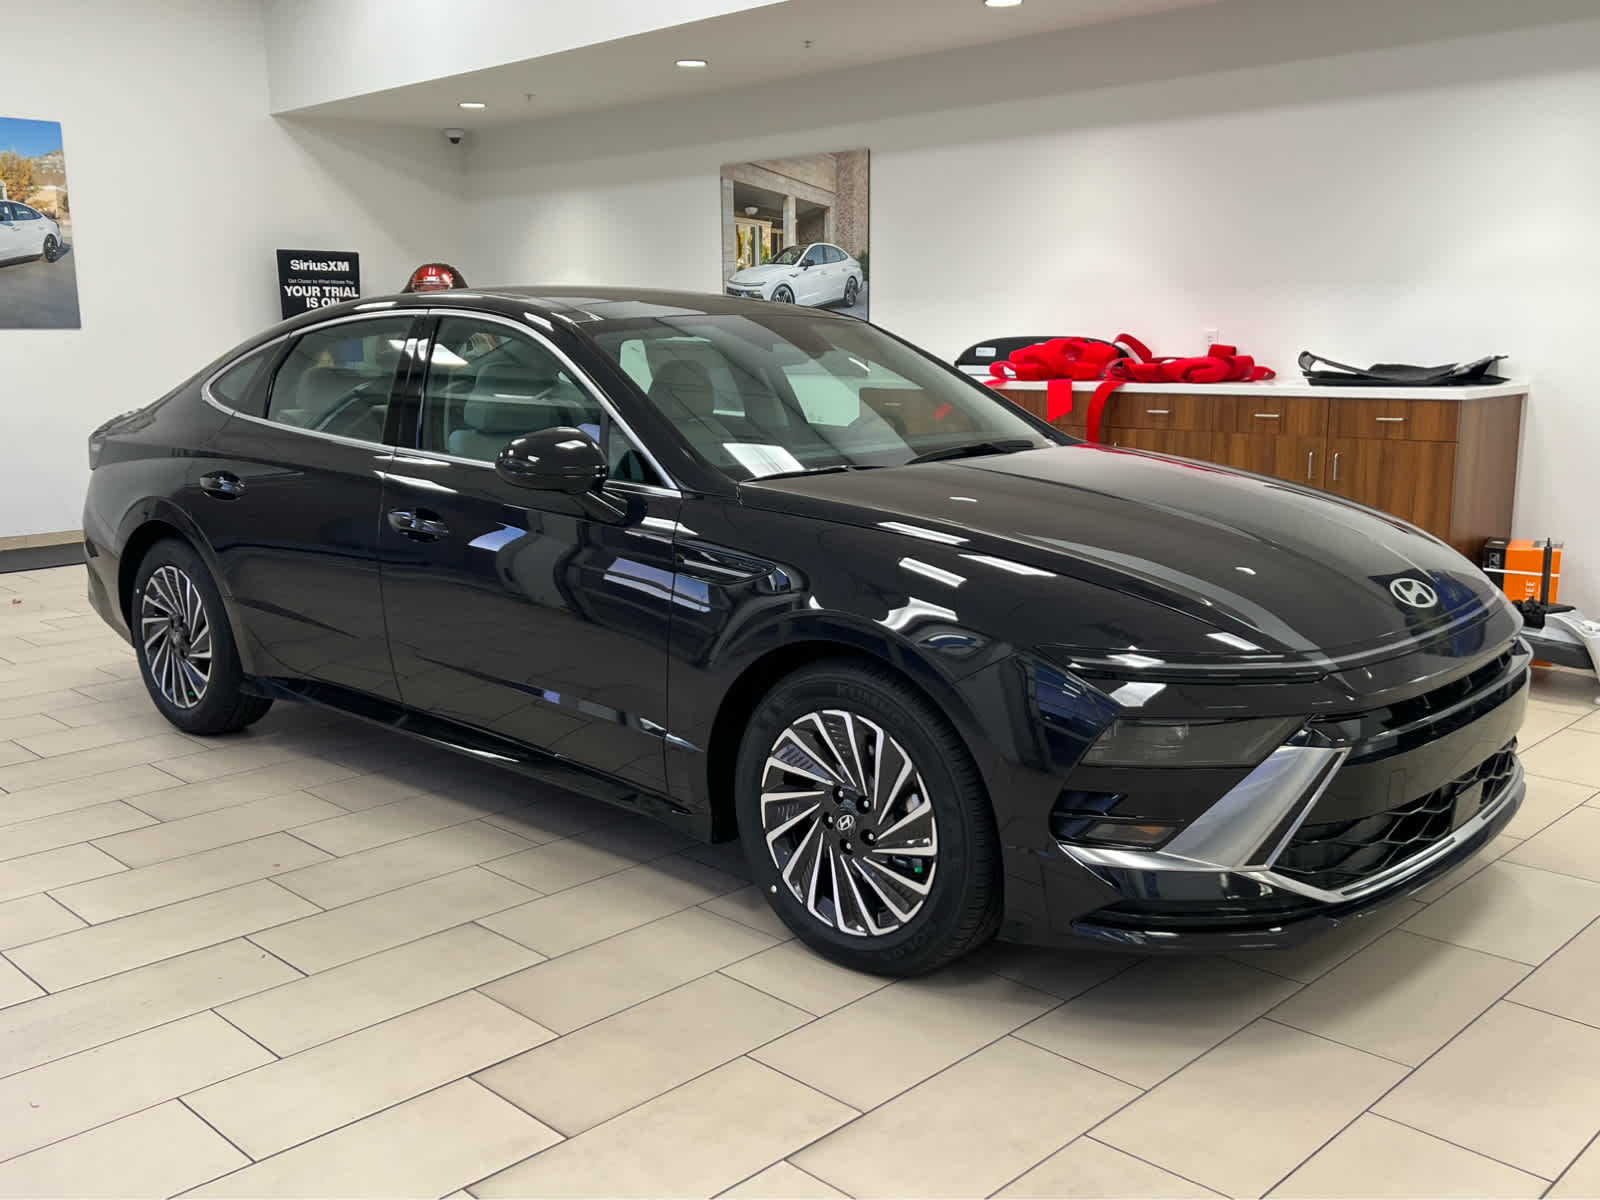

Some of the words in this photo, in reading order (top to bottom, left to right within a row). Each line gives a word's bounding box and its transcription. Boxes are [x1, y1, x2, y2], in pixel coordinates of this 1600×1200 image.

[290, 259, 350, 272] SiriusXM
[284, 285, 321, 297] YOUR
[322, 286, 359, 298] TRIAL
[306, 297, 319, 308] IS
